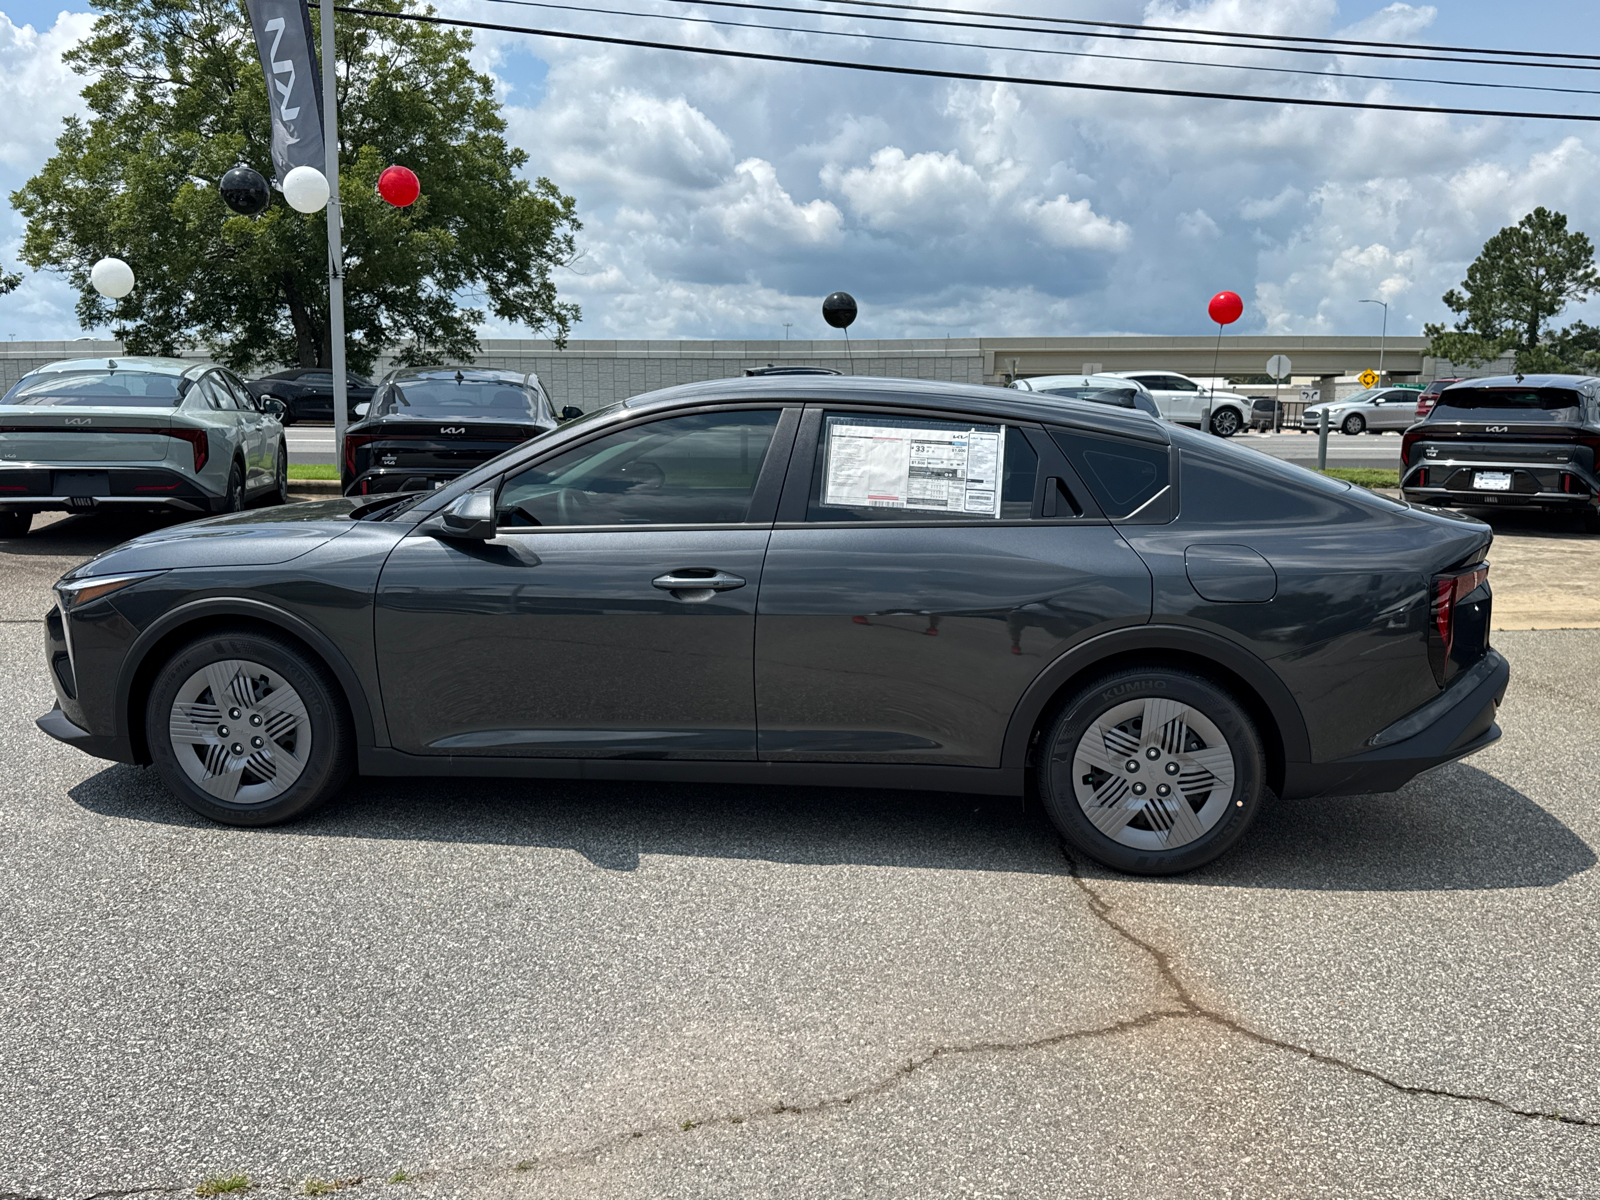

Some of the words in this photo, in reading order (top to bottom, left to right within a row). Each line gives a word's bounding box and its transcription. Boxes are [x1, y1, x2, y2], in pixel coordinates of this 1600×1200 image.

[264, 17, 301, 121] KIA
[915, 445, 925, 453] 33
[284, 662, 323, 715] KUMHO
[1101, 680, 1167, 701] KUMHO
[213, 806, 269, 821] SOLUS
[1223, 780, 1252, 835] SOLUS
